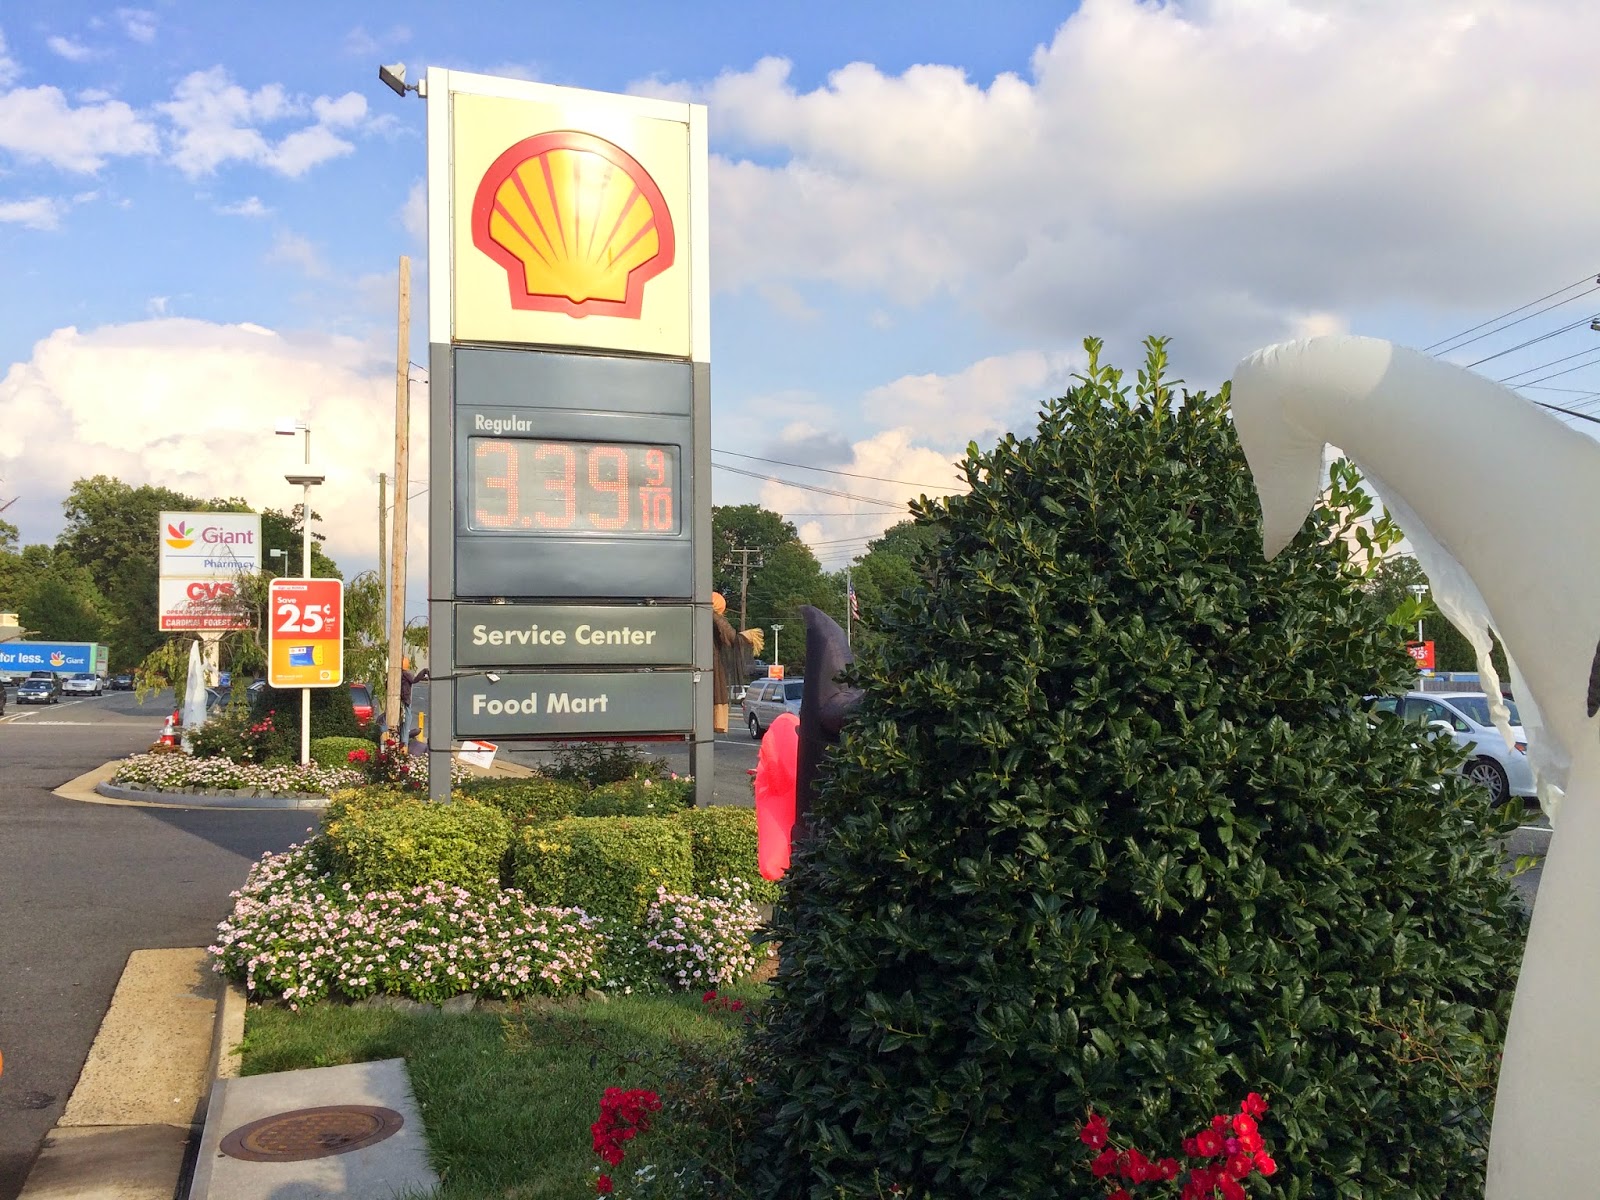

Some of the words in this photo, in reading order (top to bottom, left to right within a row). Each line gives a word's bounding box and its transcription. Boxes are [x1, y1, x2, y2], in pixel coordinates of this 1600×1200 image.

[475, 414, 533, 435] Regular
[476, 441, 629, 529] 3.39
[202, 527, 253, 544] Giant
[204, 559, 254, 570] Pharmacy
[186, 583, 236, 600] CVS
[277, 596, 297, 604] Save
[203, 618, 231, 627] FOREST
[472, 624, 567, 646] Service
[575, 624, 657, 646] Center
[18, 652, 44, 664] less.
[472, 692, 538, 715] Food
[546, 692, 609, 713] Mart
